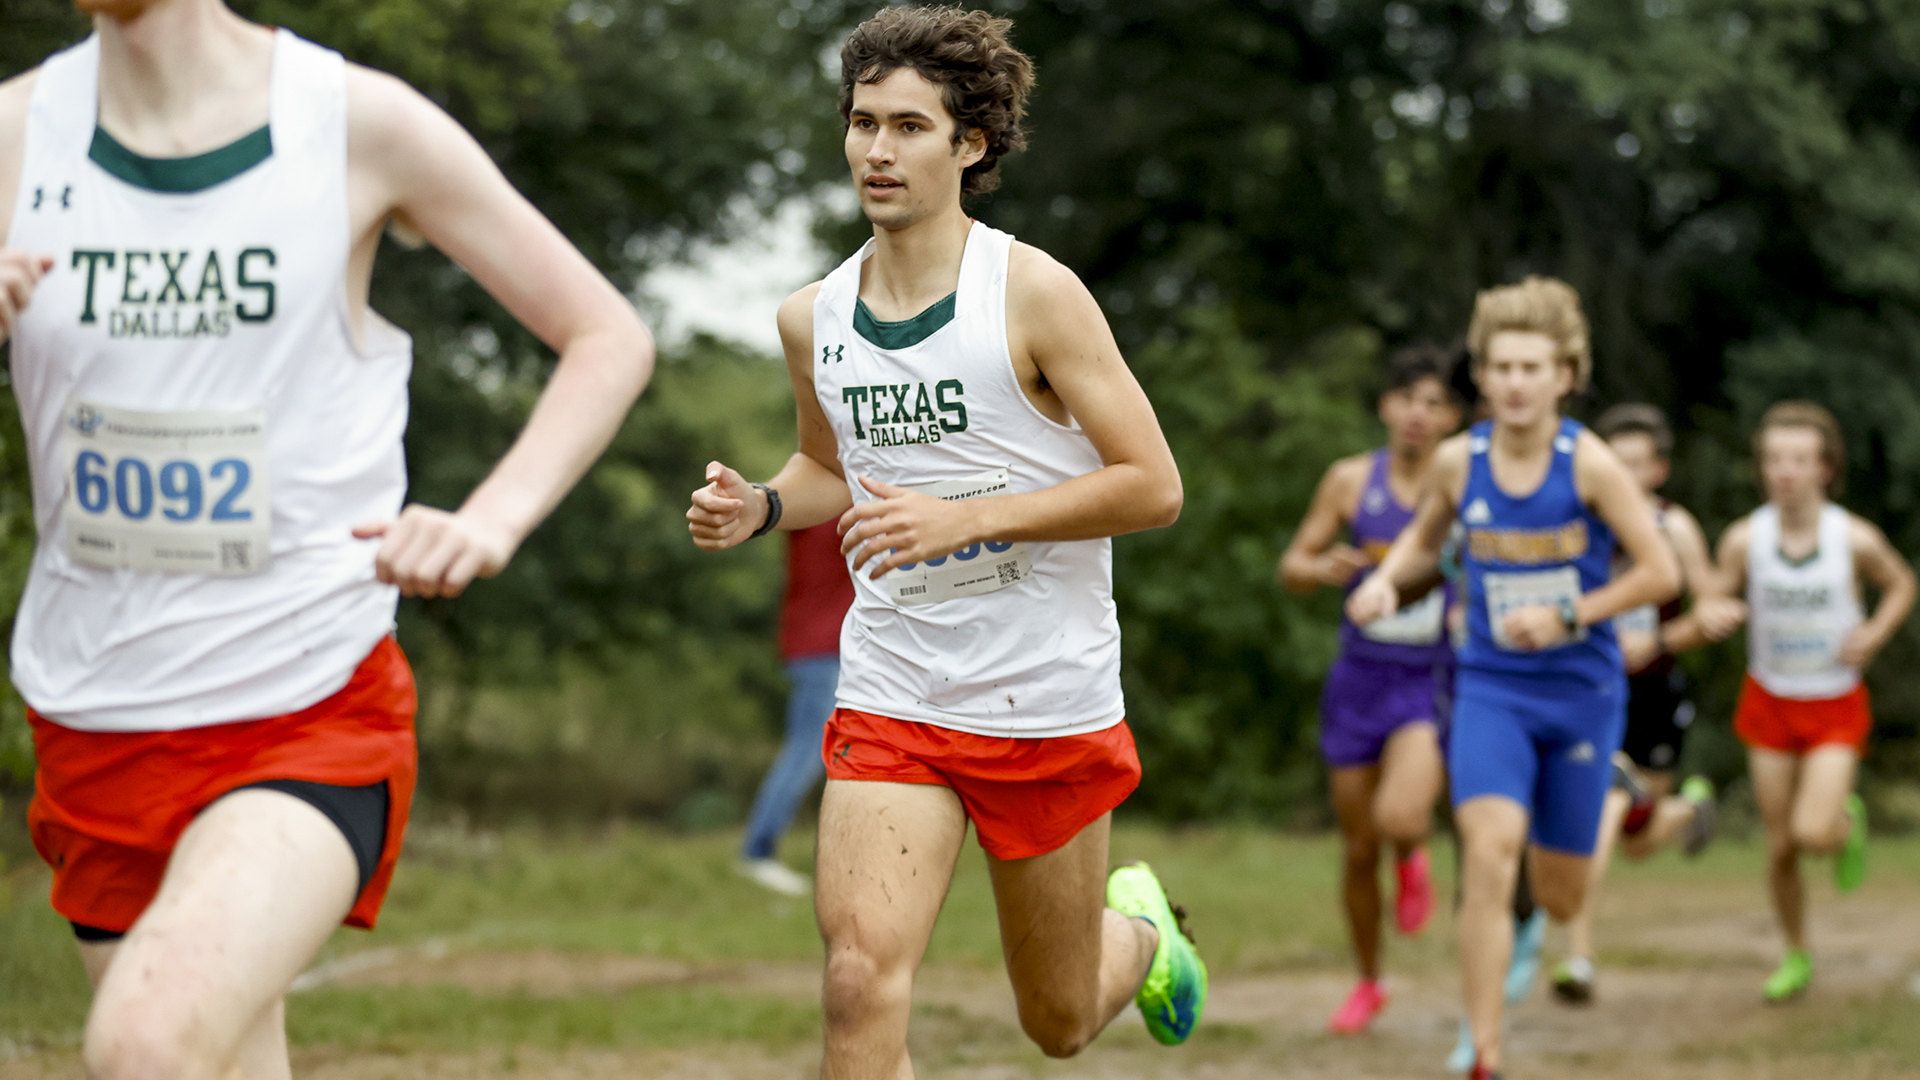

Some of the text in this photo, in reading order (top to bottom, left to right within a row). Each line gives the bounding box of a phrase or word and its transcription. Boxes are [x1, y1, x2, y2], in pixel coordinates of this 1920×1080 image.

[71, 247, 278, 324] TEXAS
[109, 309, 232, 339] DALLAS
[842, 379, 968, 439] TEXAS
[870, 425, 941, 447] DALLAS
[76, 451, 253, 522] 6092
[938, 483, 1006, 500] measure.com
